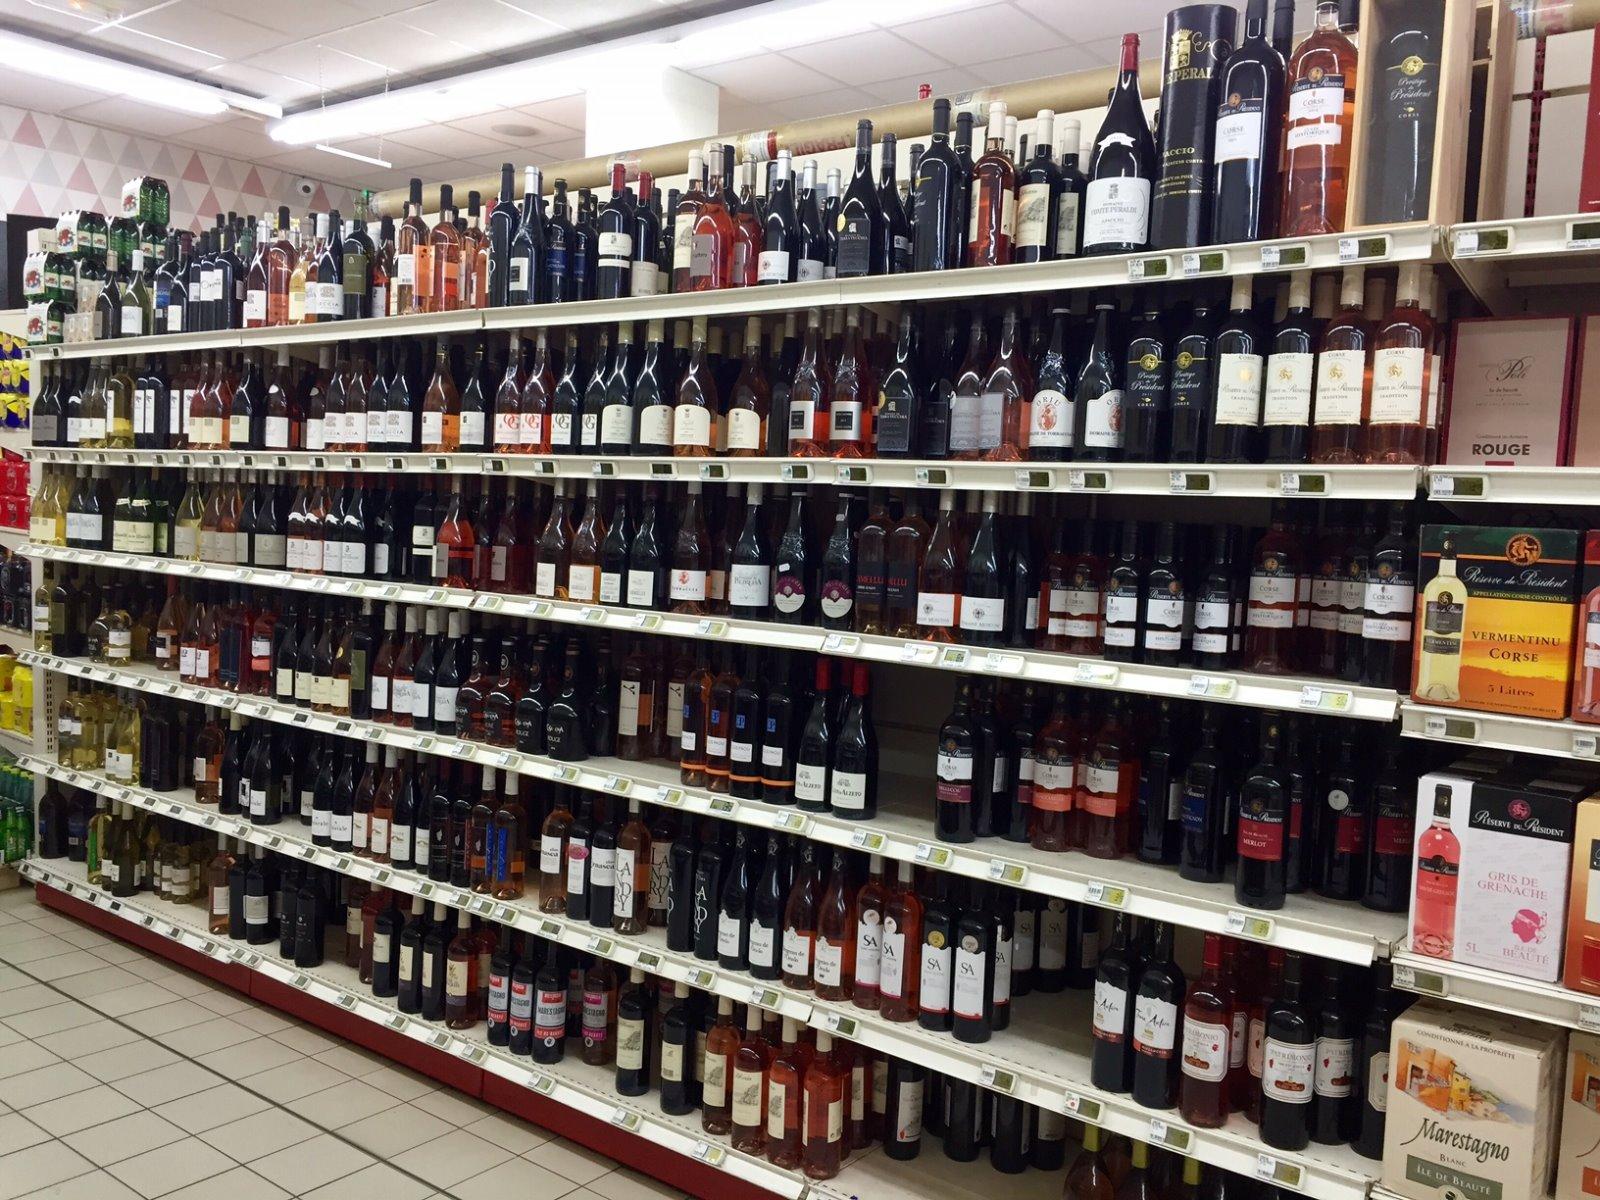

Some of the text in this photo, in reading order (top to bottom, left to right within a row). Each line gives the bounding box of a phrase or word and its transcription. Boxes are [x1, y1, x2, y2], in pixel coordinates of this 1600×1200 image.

[1303, 98, 1325, 106] CORSE
[1472, 444, 1530, 455] ROUGE
[1372, 593, 1394, 601] CORSE
[1471, 631, 1561, 647] VERMENTINU
[1489, 647, 1539, 663] CORSE
[1488, 684, 1535, 697] 5 Litres
[1473, 810, 1511, 829] RÉSERVE
[1522, 818, 1565, 837] PRÉSIDENT
[1243, 838, 1267, 847] MERLOT
[1488, 870, 1539, 888] GRIS DE
[1477, 879, 1549, 901] GRENACHE
[863, 934, 878, 948] SA
[1465, 942, 1480, 954] 5L
[883, 942, 895, 957] SA
[1502, 947, 1550, 965] BEAUTÉ
[927, 957, 942, 971] SA
[960, 962, 976, 976] SA
[1400, 1117, 1510, 1163] Marestagno
[1435, 1171, 1448, 1182] DE
[1453, 1175, 1491, 1195] BEAUTÉ
